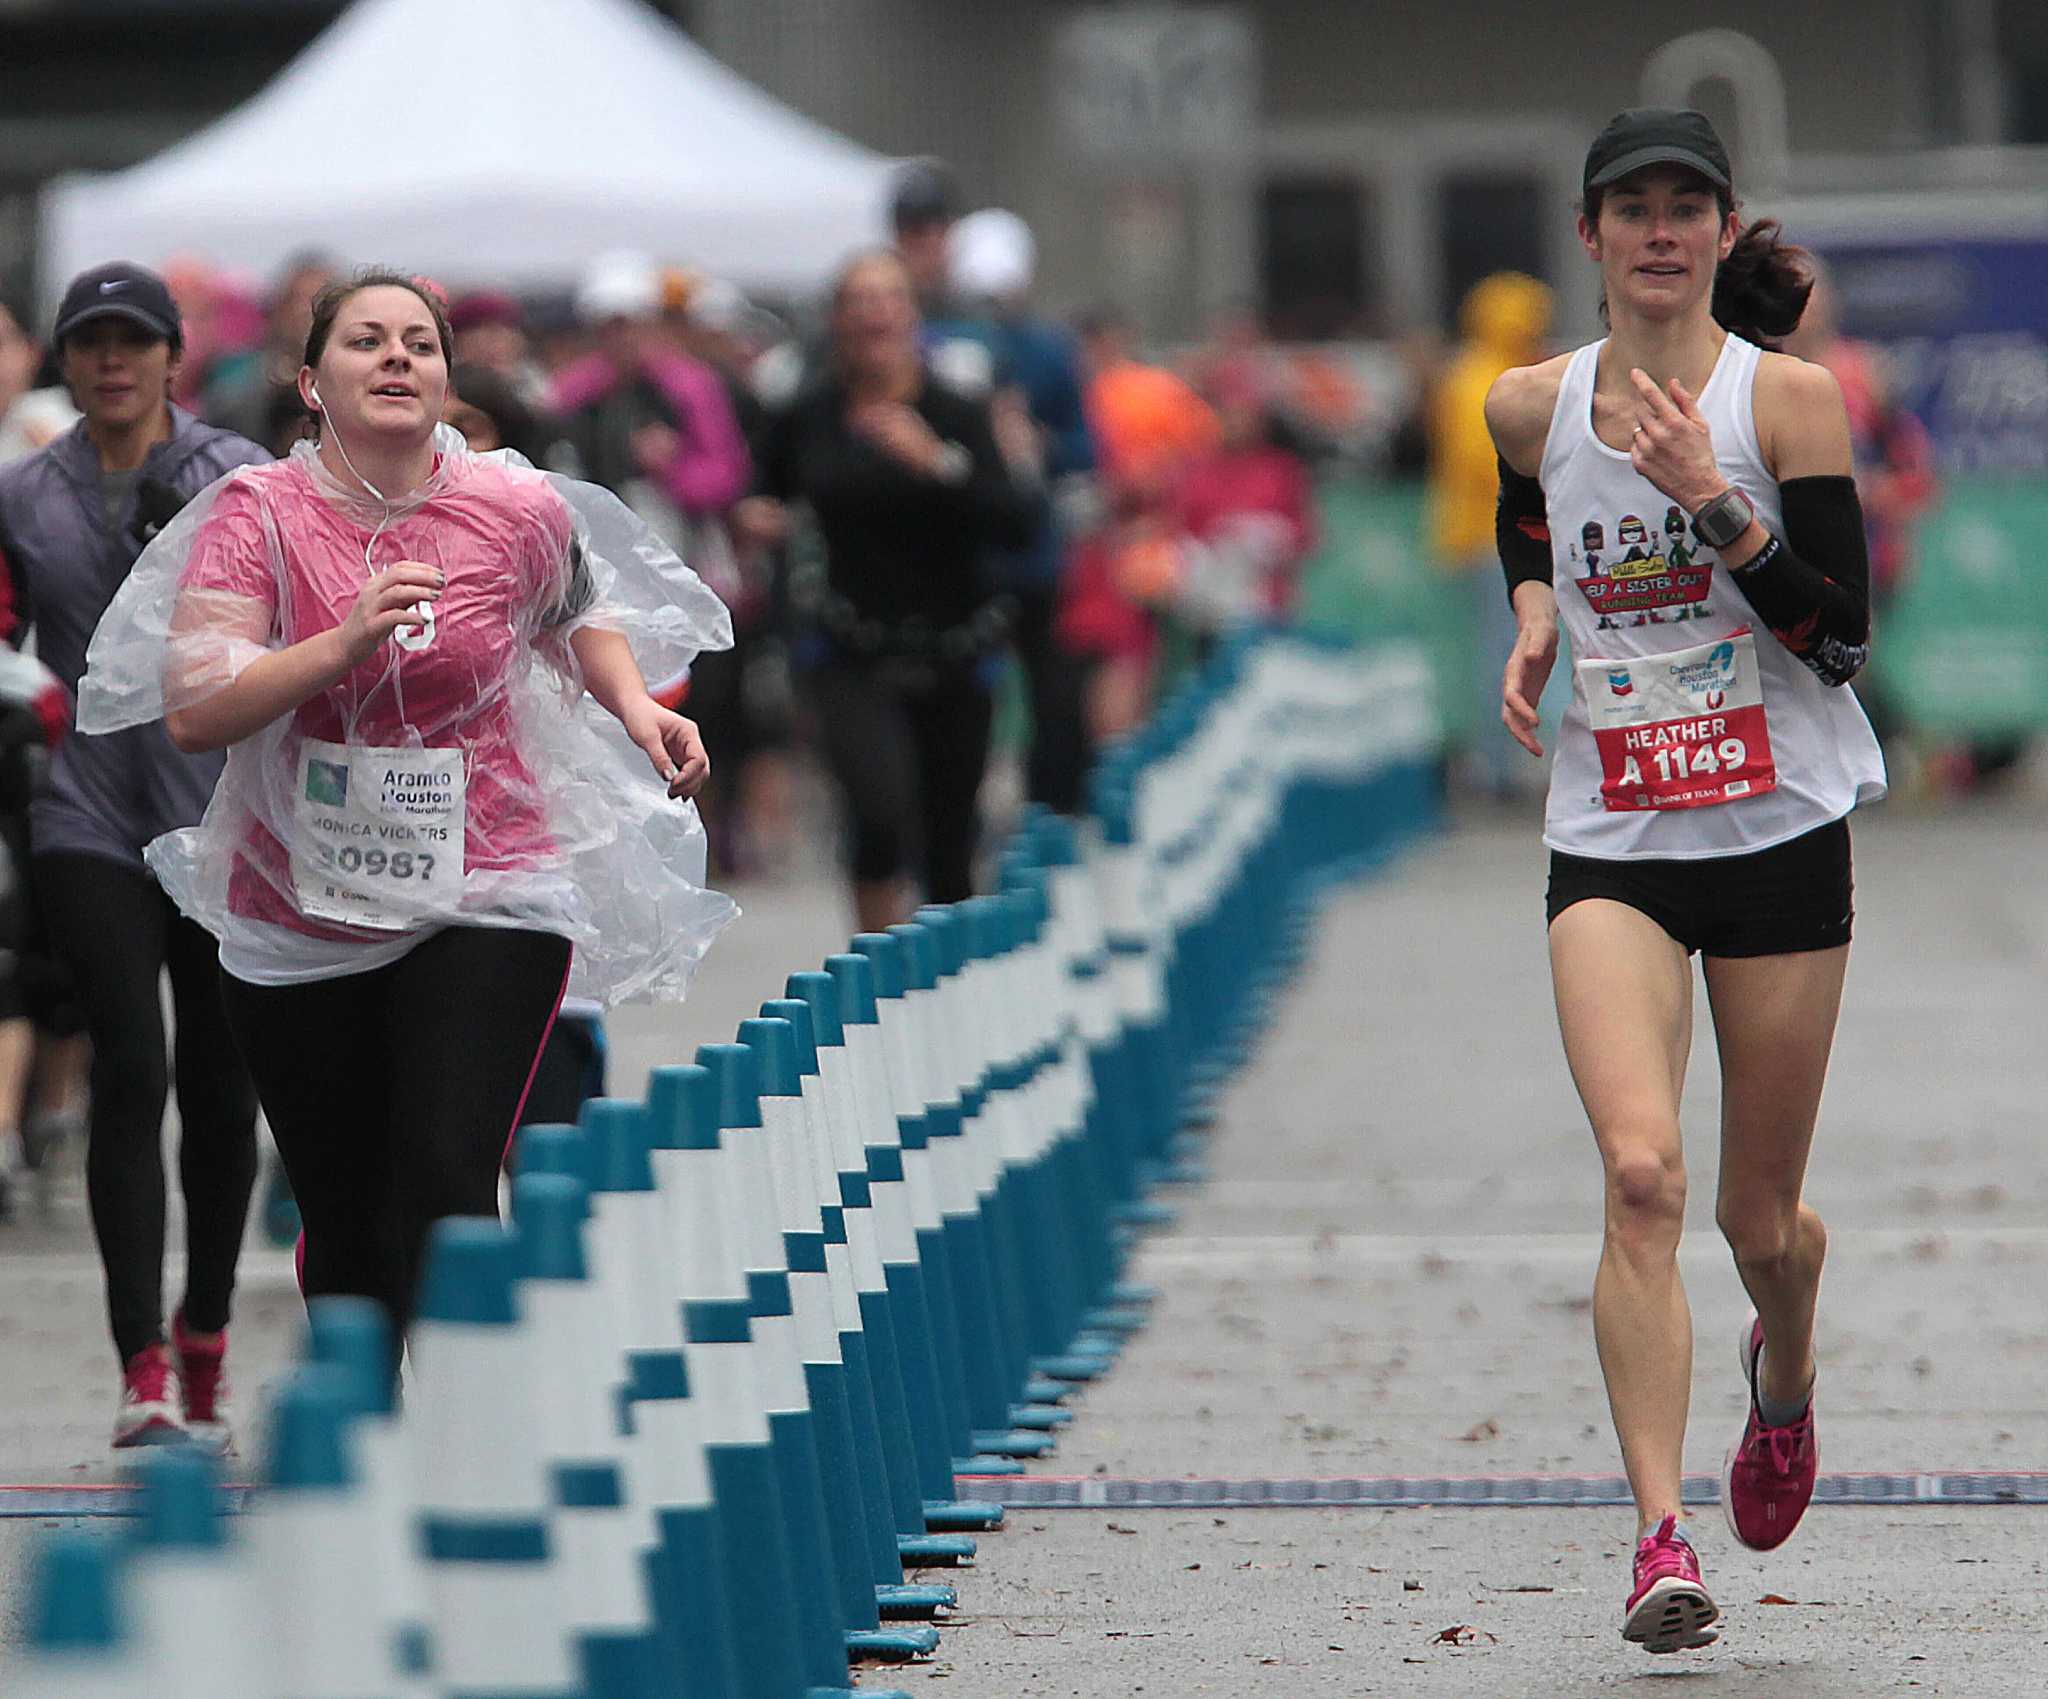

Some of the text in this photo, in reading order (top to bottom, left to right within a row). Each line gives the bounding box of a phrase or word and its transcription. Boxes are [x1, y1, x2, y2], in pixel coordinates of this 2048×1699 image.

[1613, 584, 1622, 594] A
[1627, 576, 1672, 594] SISTER
[1679, 670, 1718, 686] Houston
[1625, 718, 1726, 750] HEATHER
[1618, 737, 1746, 786] A 1149
[319, 843, 435, 880] 0987
